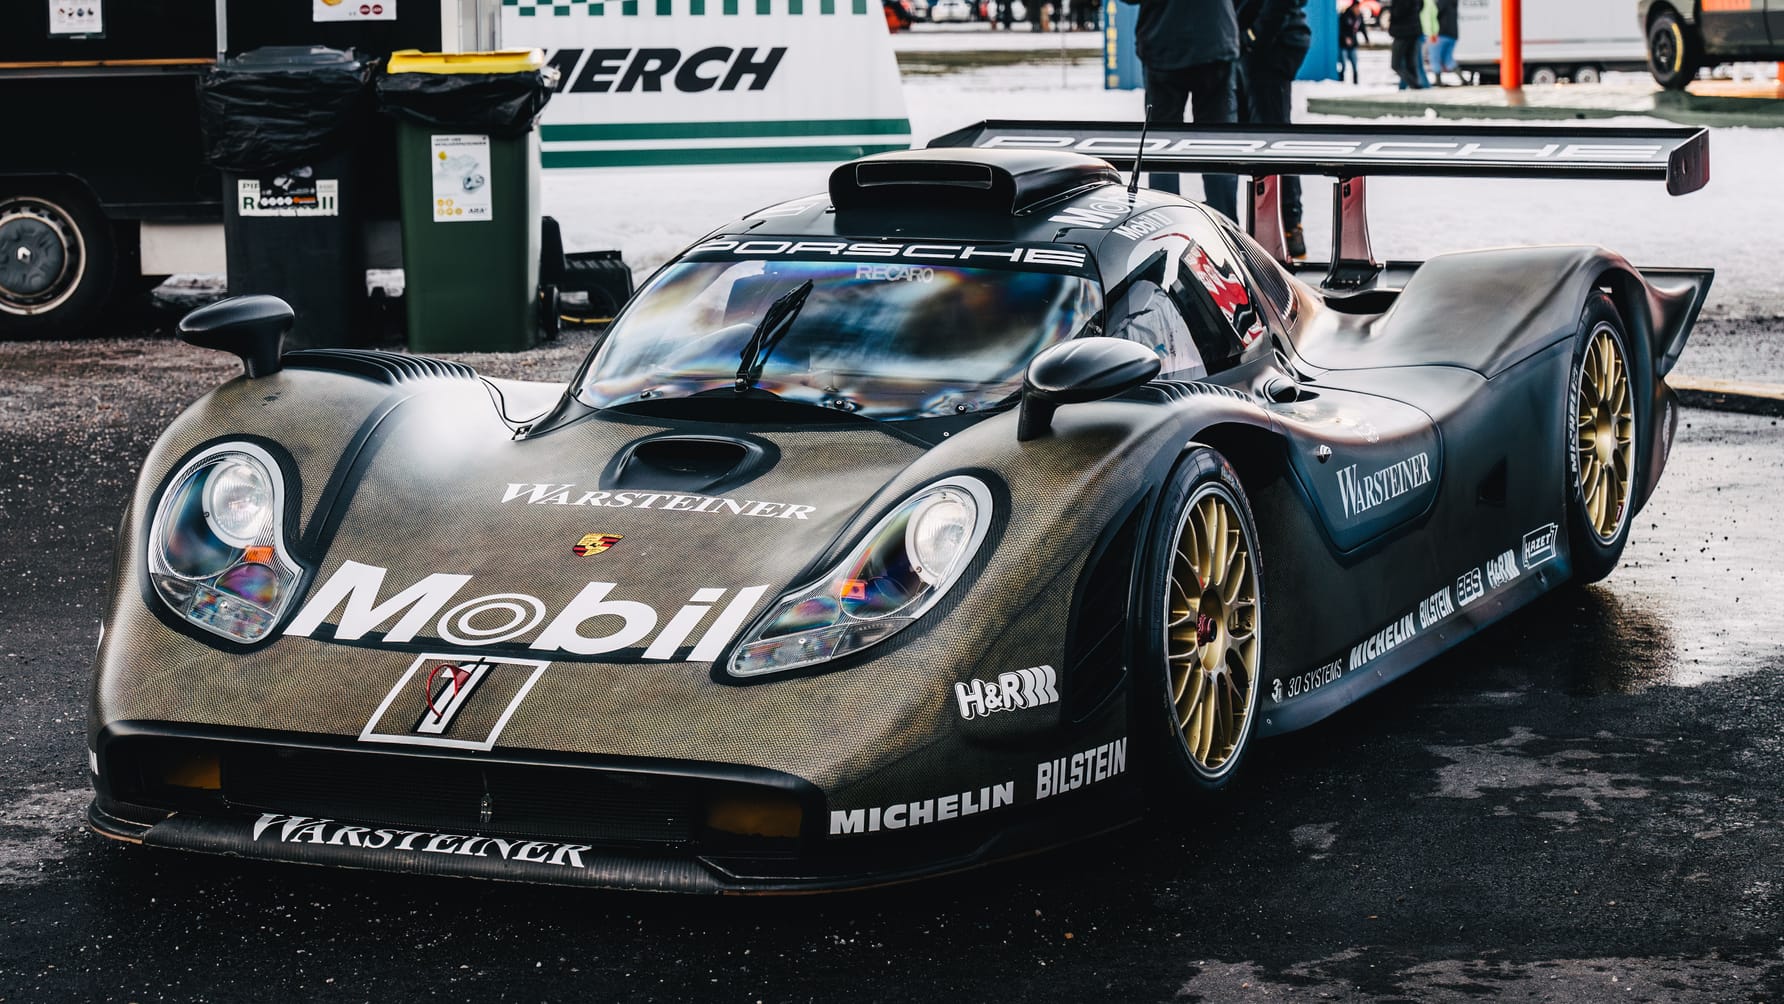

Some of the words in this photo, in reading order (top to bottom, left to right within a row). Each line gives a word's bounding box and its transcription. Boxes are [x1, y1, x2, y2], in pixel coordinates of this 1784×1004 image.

[979, 136, 1662, 158] PORSCHE
[1112, 214, 1163, 241] Mobil
[692, 240, 1086, 268] PORSCHE
[855, 265, 934, 282] RECARO
[501, 483, 816, 521] WARSTEINER
[1336, 452, 1432, 518] WARSTEINER
[1525, 533, 1551, 560] HAZET
[1419, 585, 1455, 629] BILSTEIN
[1457, 567, 1484, 607] BBS
[283, 560, 770, 662] Mobil
[1349, 612, 1416, 671] MICHELIN
[1287, 676, 1302, 697] 3D
[1303, 660, 1343, 692] SYSTEMS
[1036, 737, 1127, 800] BILSTEIN
[829, 781, 1015, 836] MICHELIN
[252, 812, 593, 869] WARSTEINER
